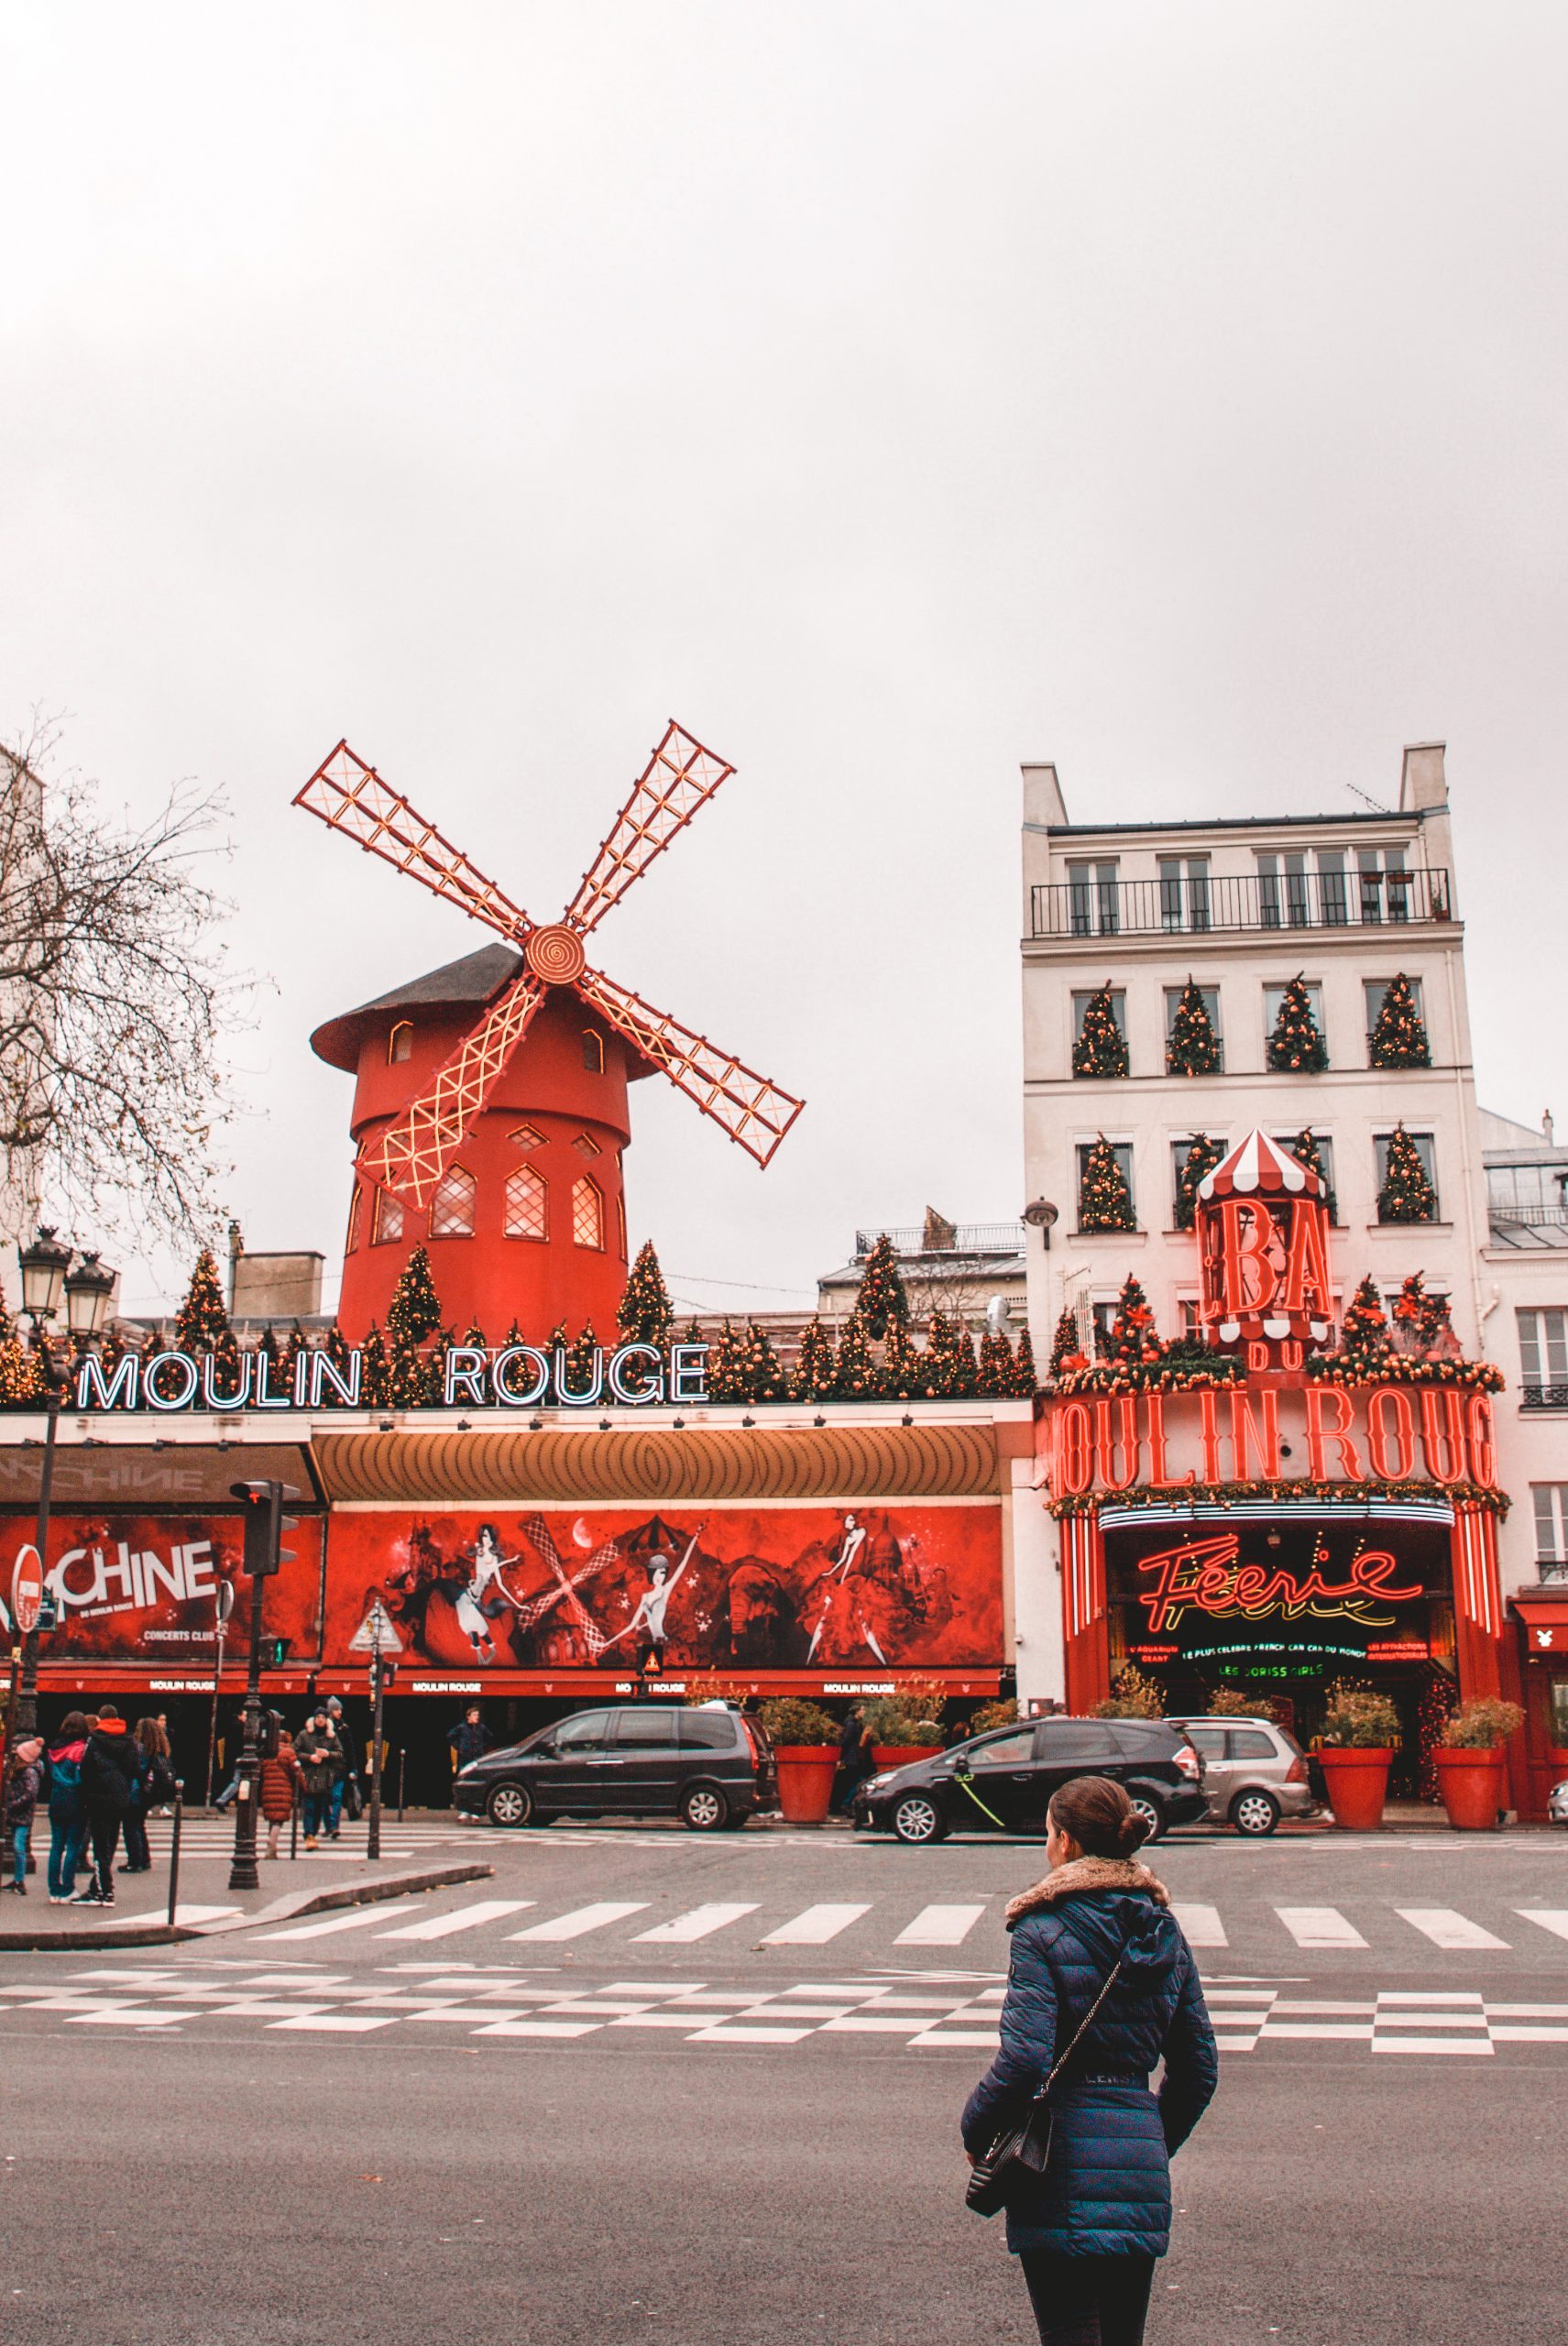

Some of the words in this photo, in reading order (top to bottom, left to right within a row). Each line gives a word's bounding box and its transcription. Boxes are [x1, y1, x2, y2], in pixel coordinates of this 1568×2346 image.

[1248, 1342, 1304, 1372] DU
[78, 1351, 361, 1409] MOULIN
[444, 1343, 709, 1405] ROUGE
[1304, 1387, 1499, 1490] ROUG
[144, 1630, 190, 1641] CONCERTS
[192, 1630, 215, 1641] CLUB
[149, 1681, 184, 1690] MOULIN
[185, 1681, 215, 1690] ROUGE
[412, 1683, 448, 1692] MOULIN
[449, 1683, 481, 1693] ROUGE
[824, 1683, 860, 1694] MOULIN
[861, 1683, 895, 1694] ROUGE
